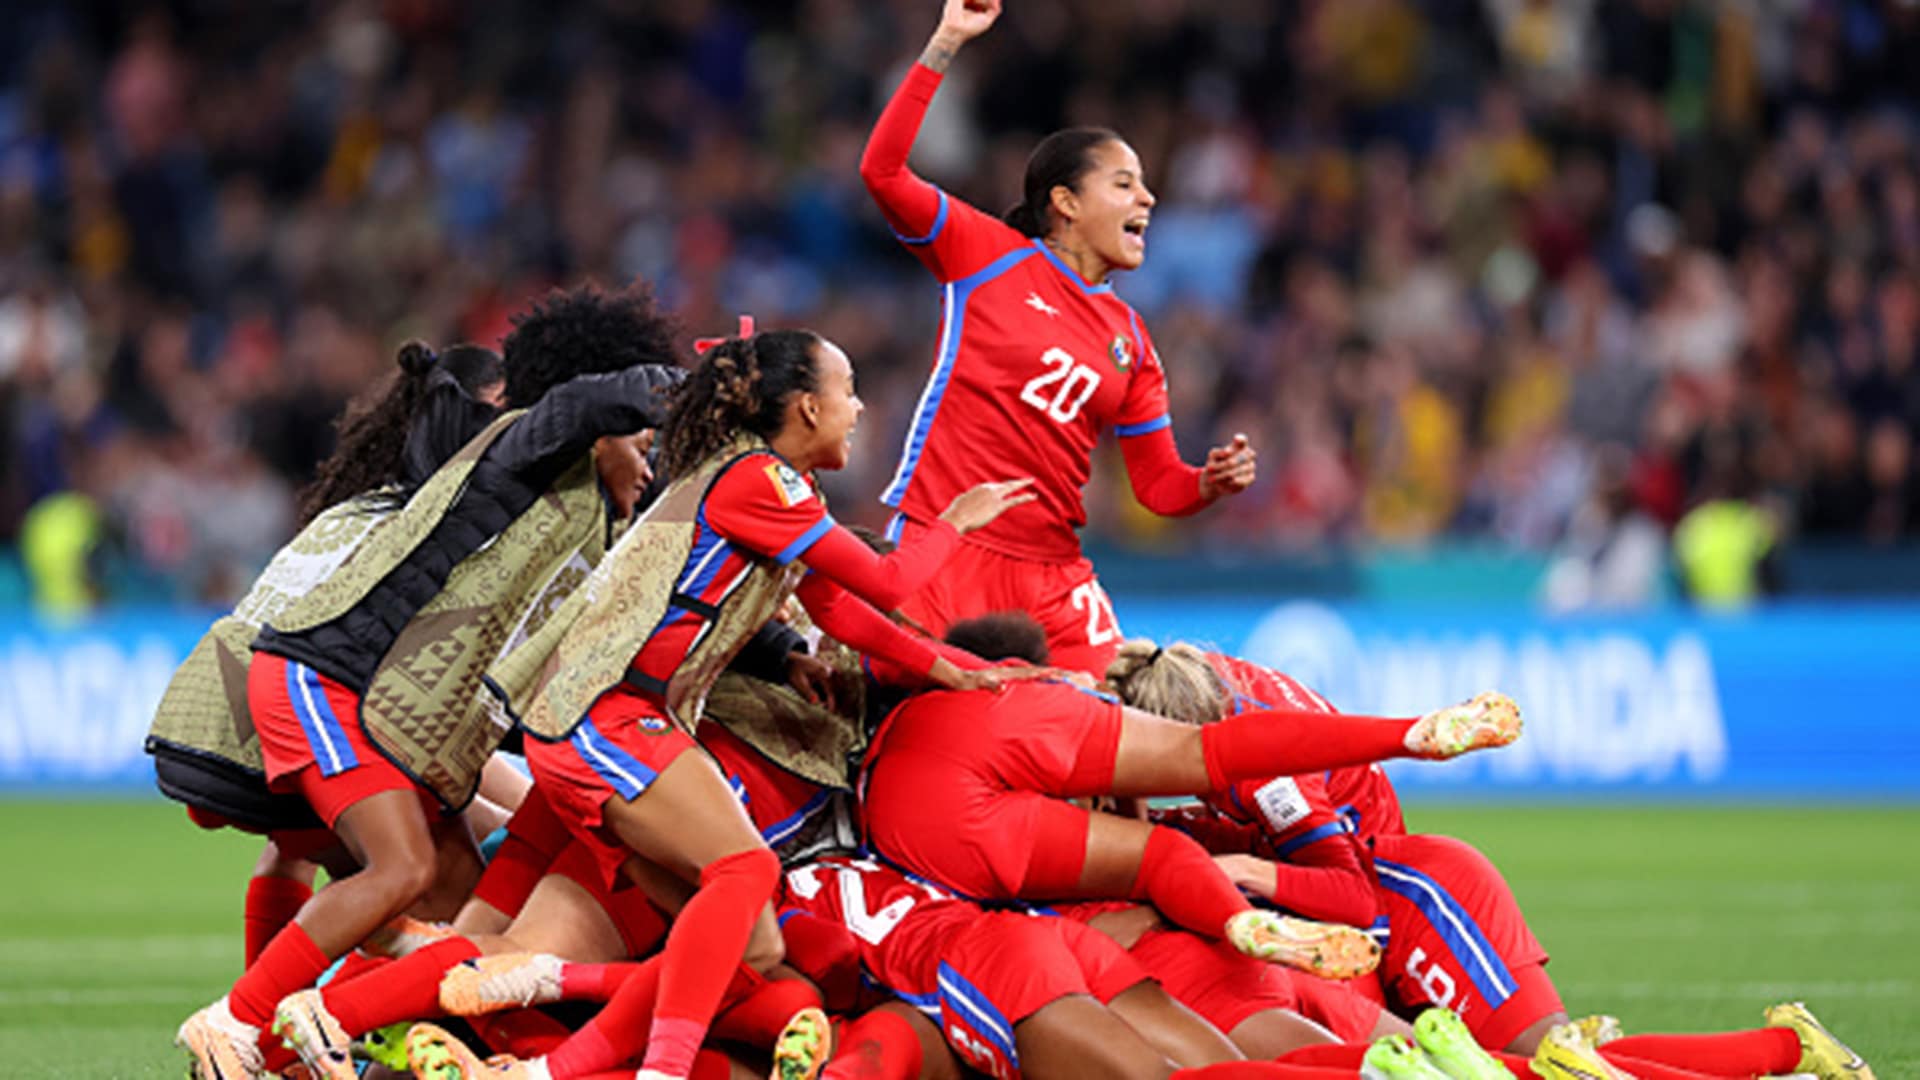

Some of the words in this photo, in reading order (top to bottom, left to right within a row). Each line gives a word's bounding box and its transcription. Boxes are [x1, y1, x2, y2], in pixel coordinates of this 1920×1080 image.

[1020, 347, 1102, 424] 20
[787, 858, 944, 946] 2
[1406, 947, 1456, 1008] 6
